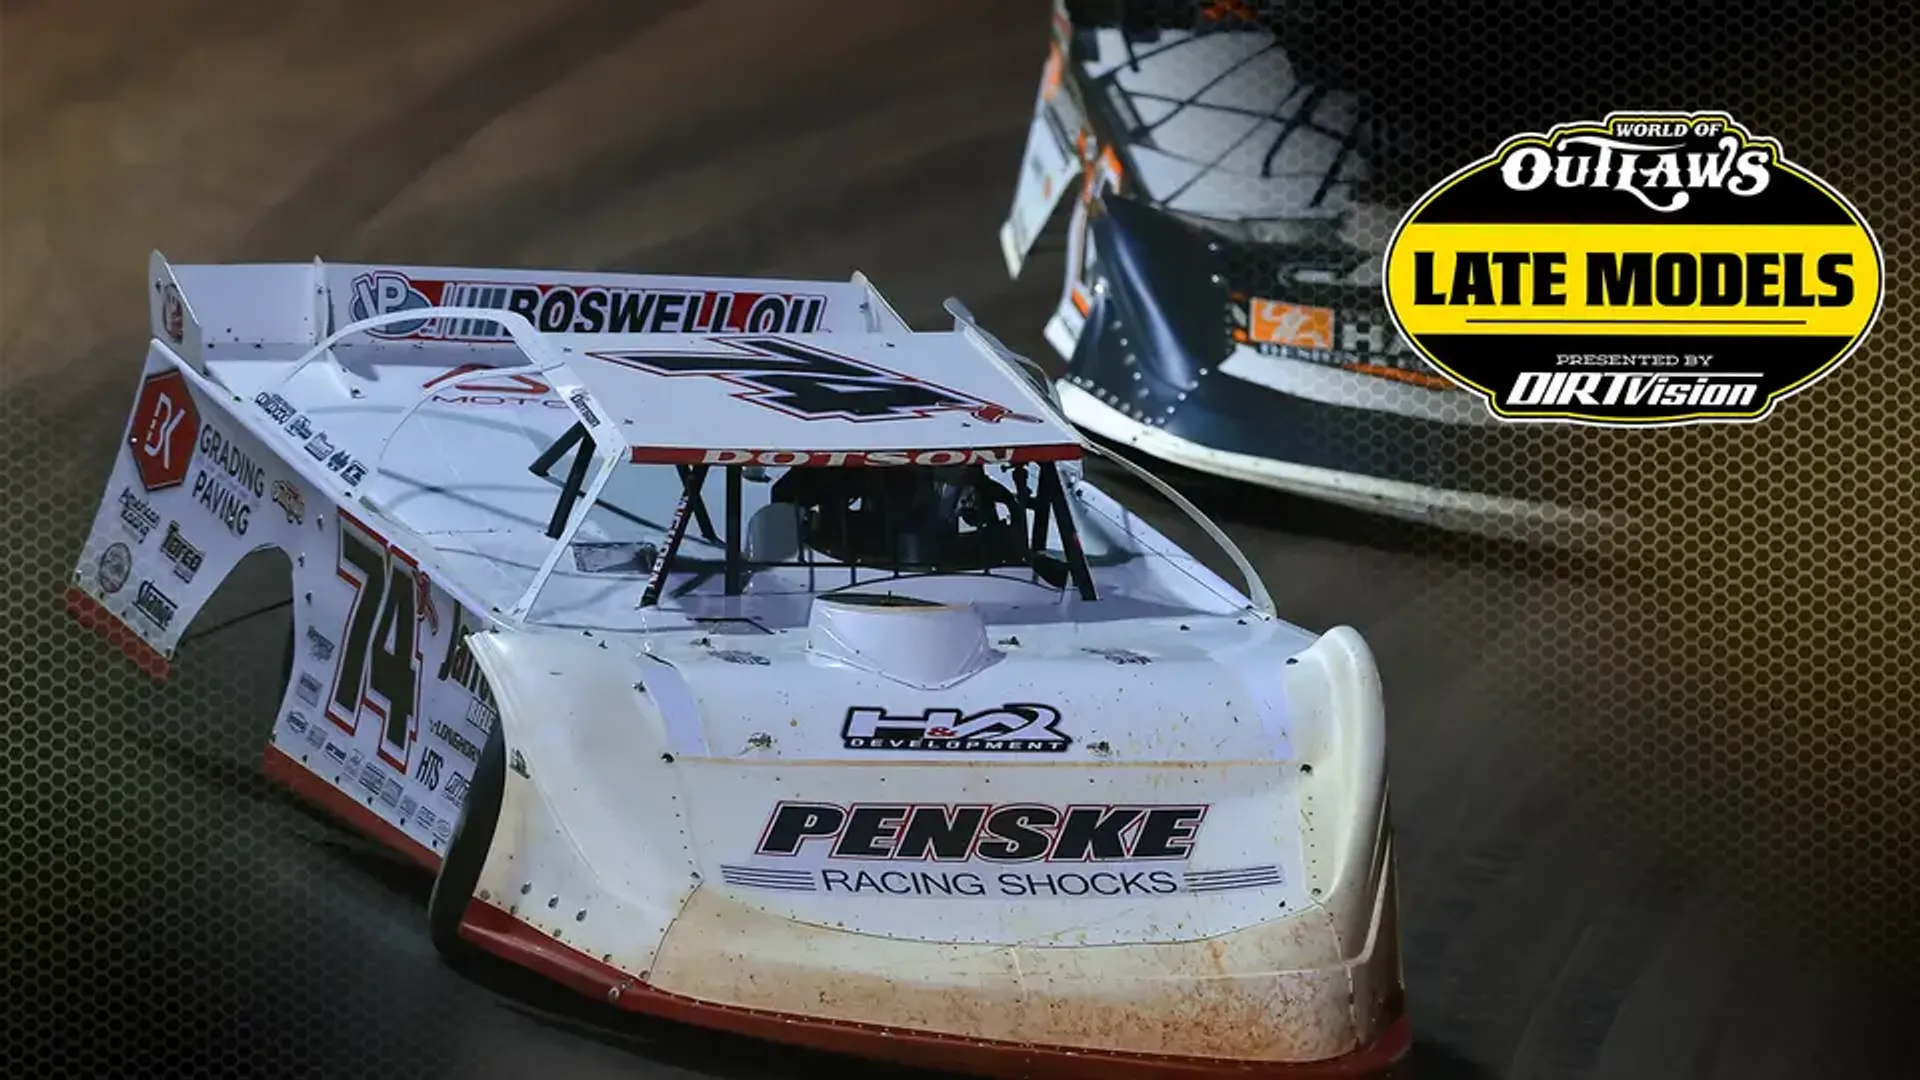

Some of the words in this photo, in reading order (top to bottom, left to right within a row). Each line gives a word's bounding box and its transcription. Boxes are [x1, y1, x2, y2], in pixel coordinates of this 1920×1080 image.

[507, 286, 737, 333] BOSWELL
[199, 423, 266, 499] GRADING
[702, 448, 1015, 467] DOTSON
[191, 469, 251, 536] PAVING
[325, 506, 424, 774] 74
[849, 737, 1065, 750] DEVELOPMENT
[415, 745, 444, 793] HTS
[754, 801, 1208, 862] PENSKE
[821, 869, 986, 896] RACING
[1000, 872, 1178, 896] SHOCKS
